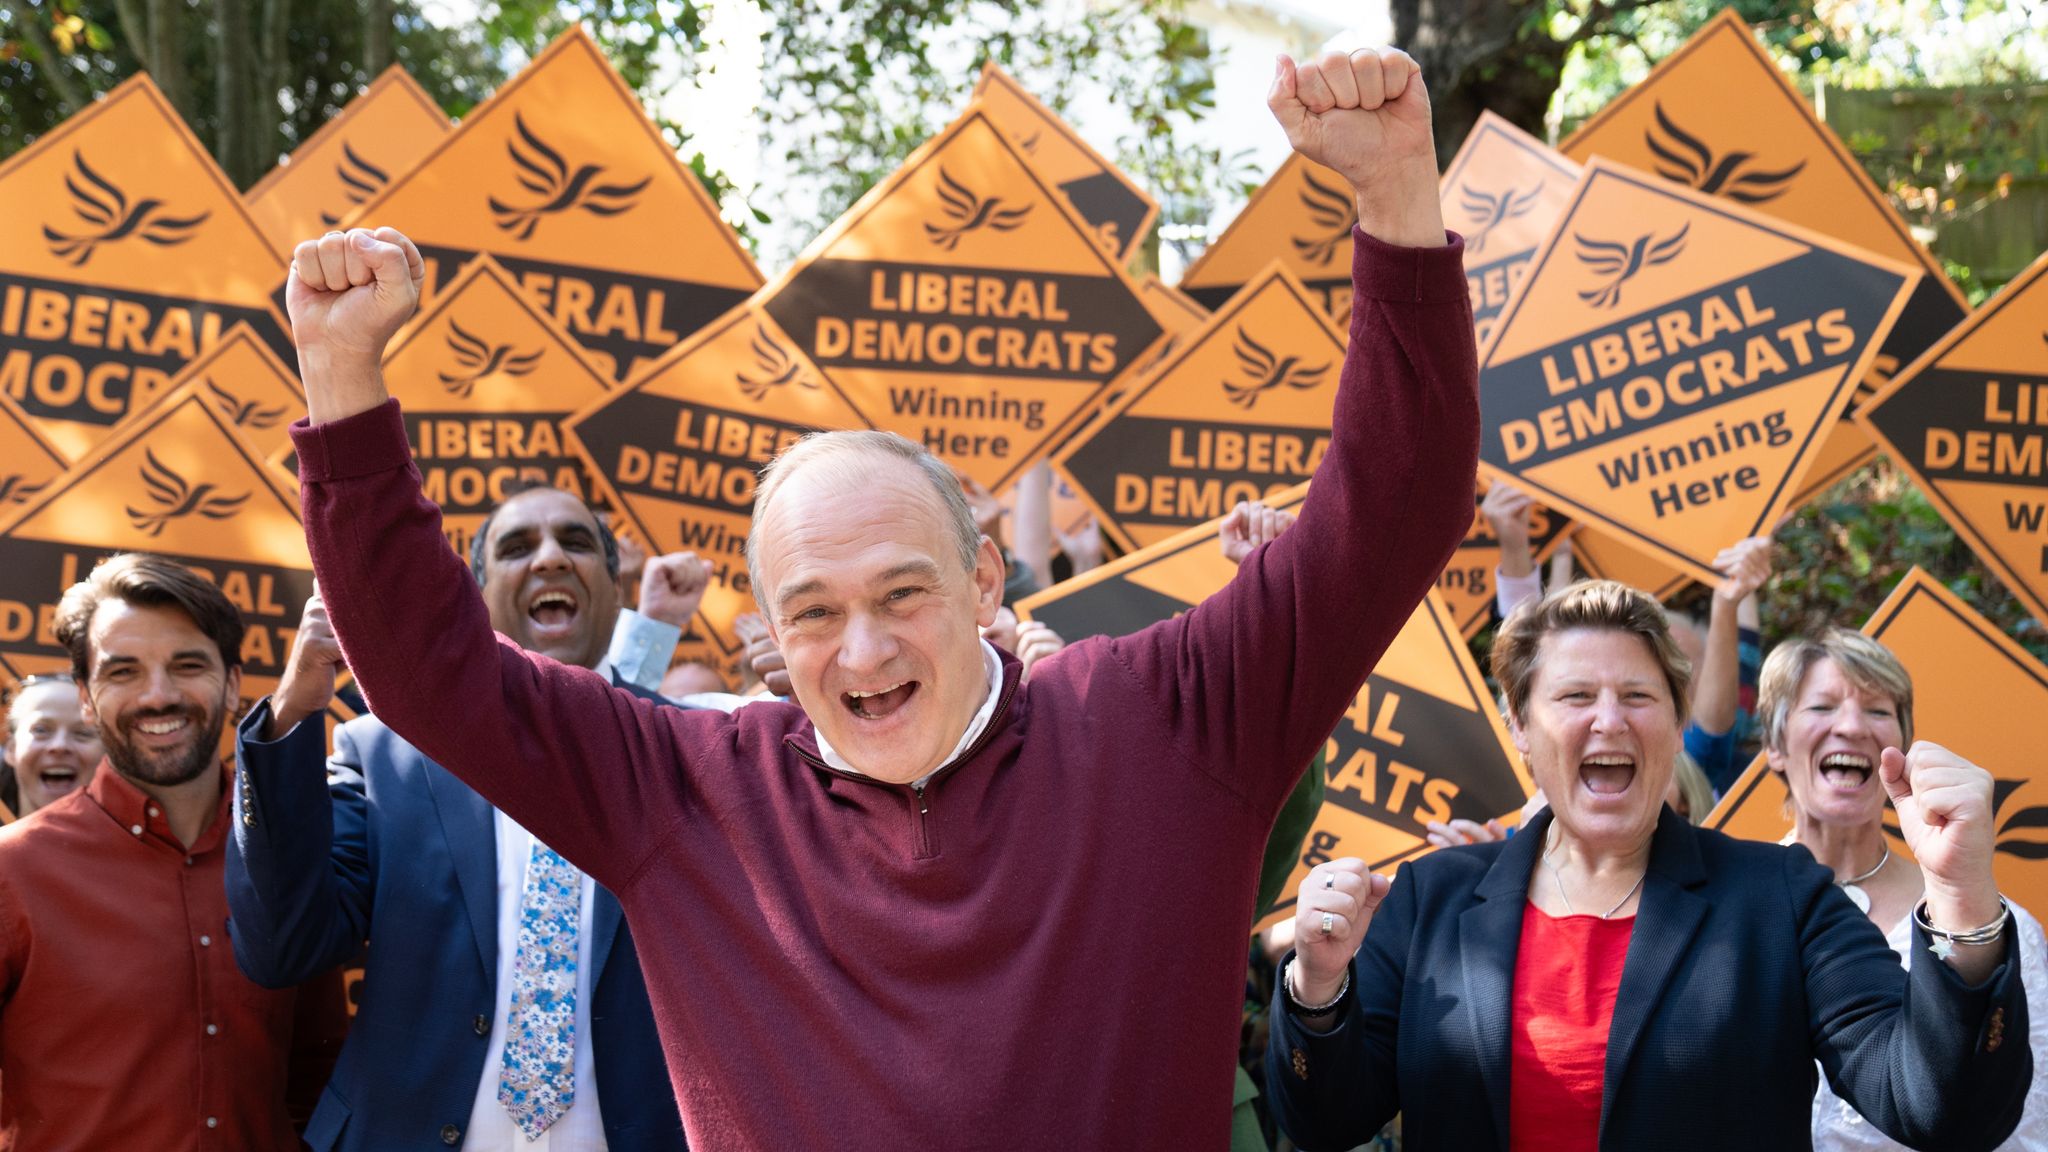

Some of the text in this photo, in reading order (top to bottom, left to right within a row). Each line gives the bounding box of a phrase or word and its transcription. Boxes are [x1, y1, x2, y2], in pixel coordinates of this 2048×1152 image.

[870, 269, 1069, 322] LIBERAL
[814, 316, 1118, 374] DEMOCRATS
[1541, 285, 1776, 397] LIBERAL
[890, 387, 1045, 430] Winning
[1499, 308, 1856, 465] DEMOCRATS
[923, 427, 1009, 457] Here
[1598, 409, 1794, 490] Winning
[1924, 427, 2048, 477] DEM
[1650, 465, 1761, 519] Here
